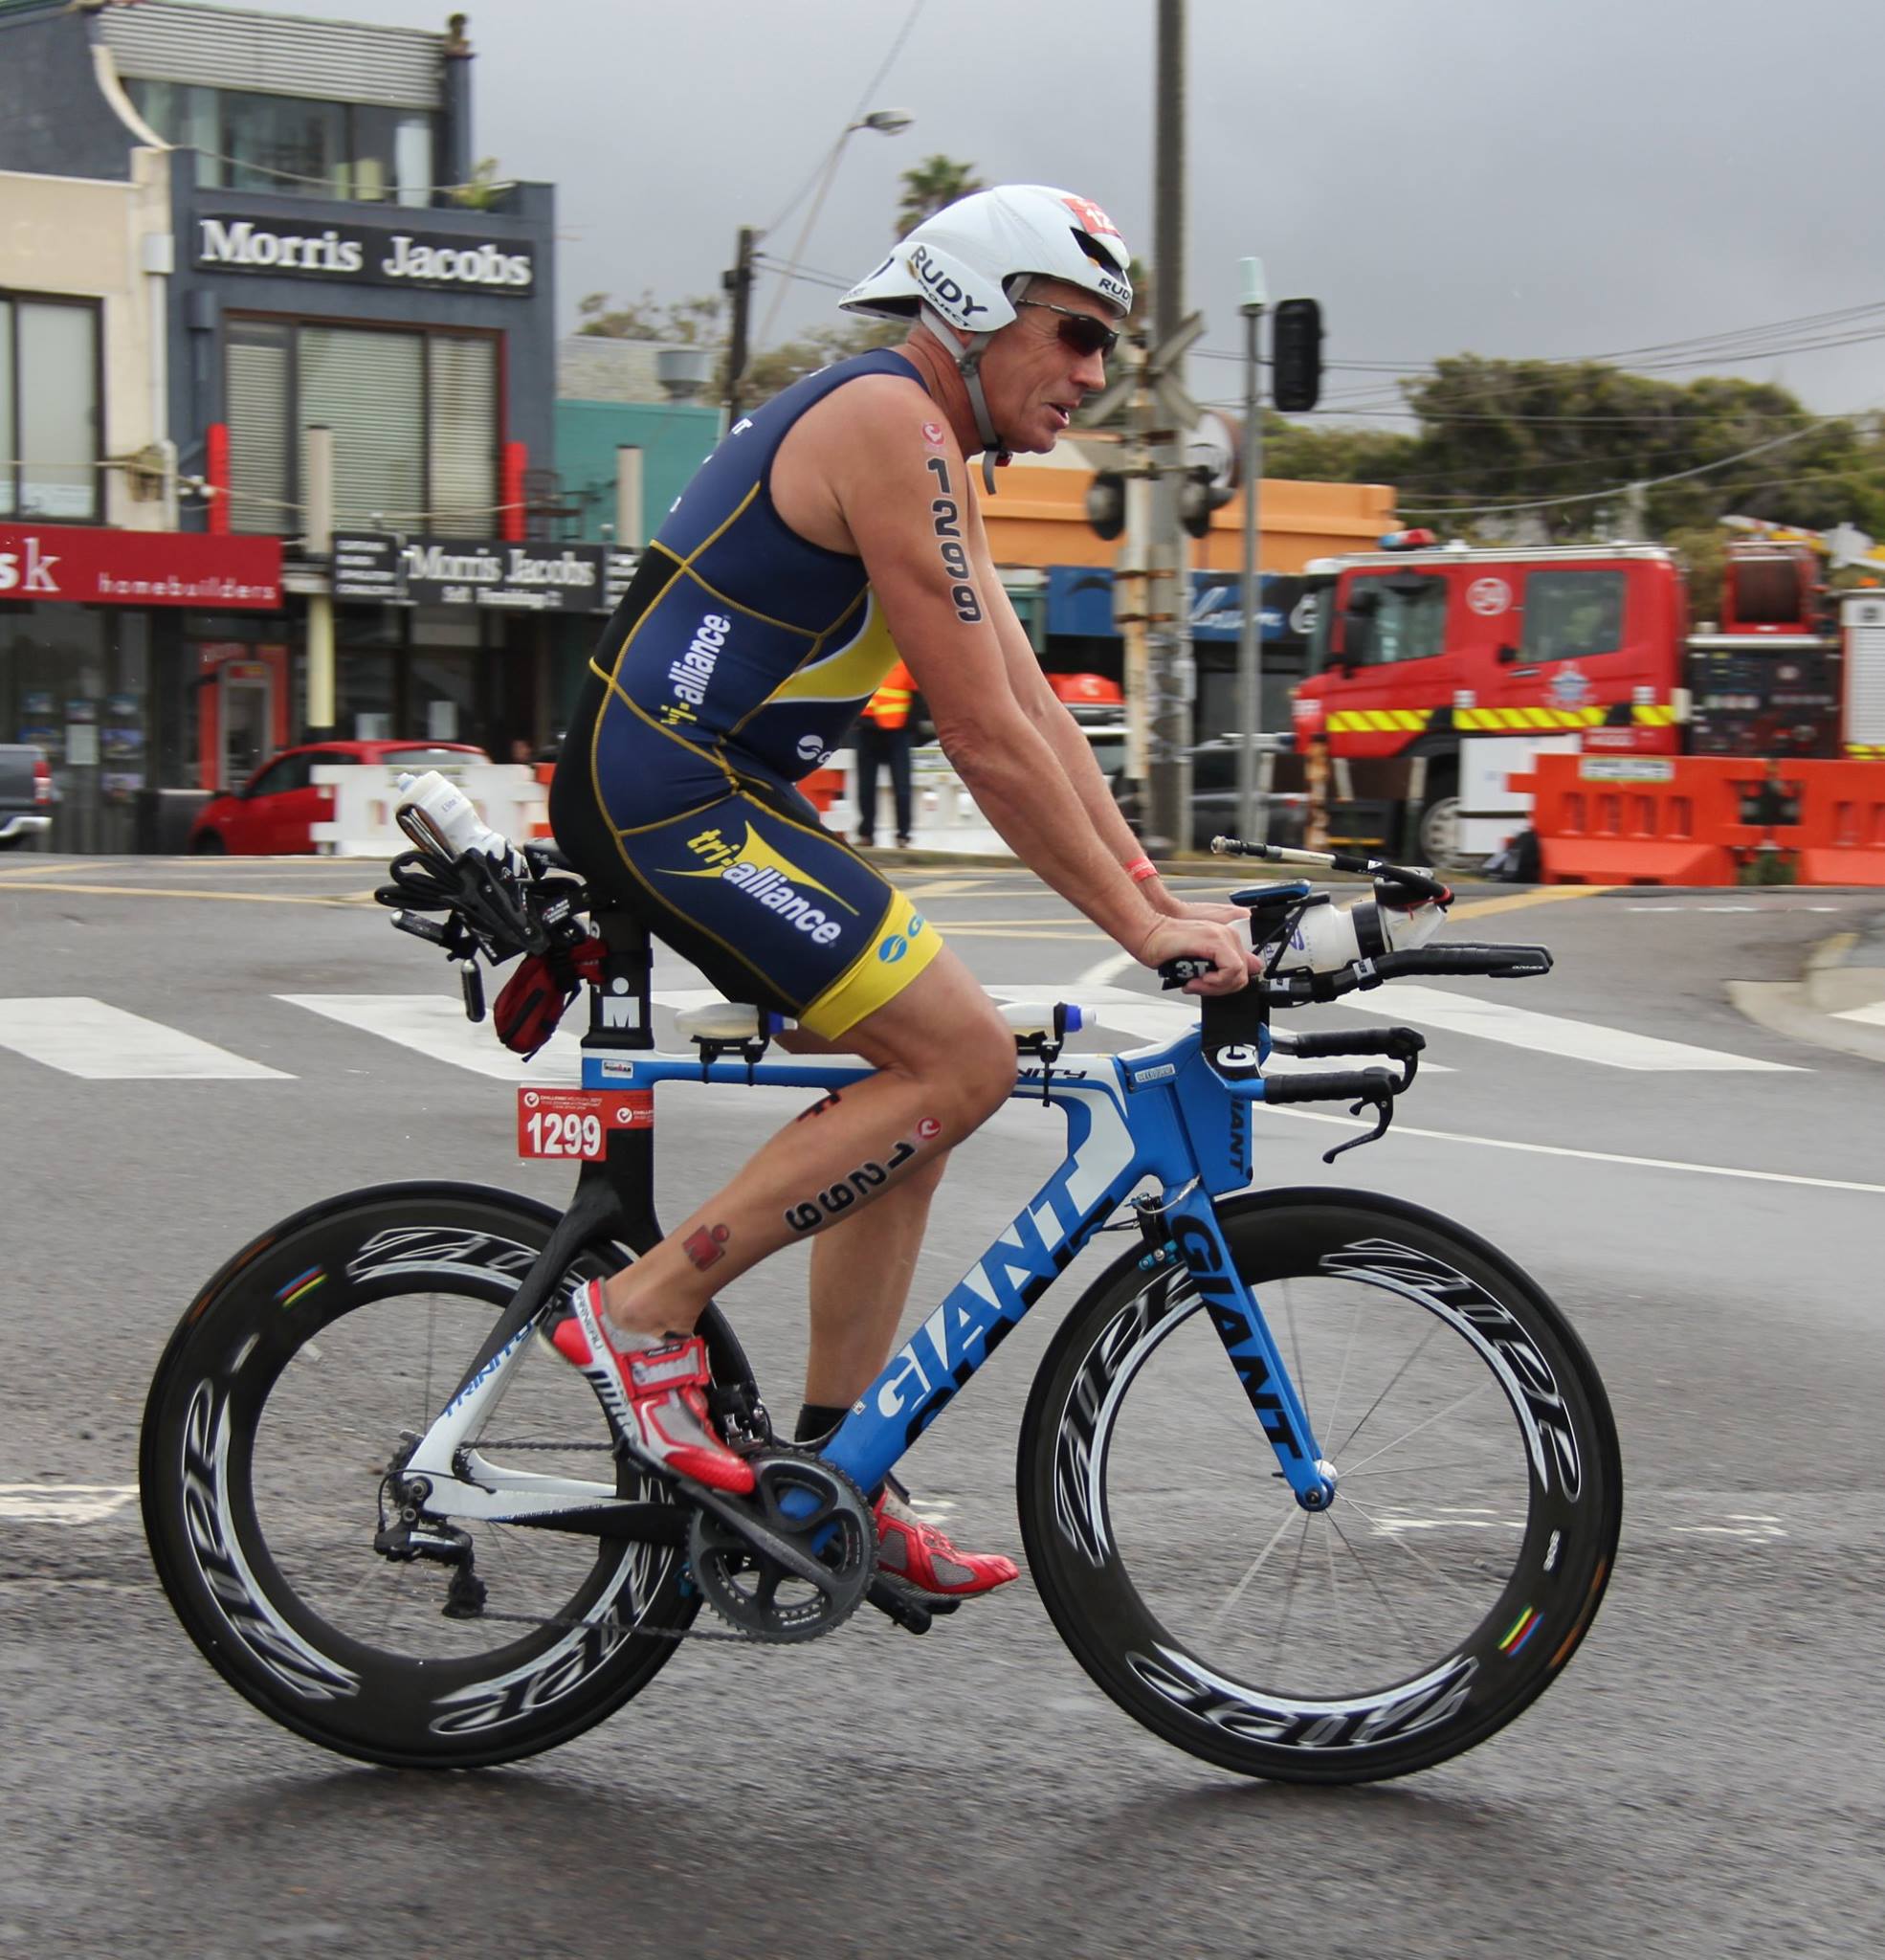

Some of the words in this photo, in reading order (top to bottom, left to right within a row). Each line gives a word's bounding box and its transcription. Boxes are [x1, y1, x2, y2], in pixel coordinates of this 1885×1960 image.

[199, 219, 364, 273] Morris
[382, 235, 532, 286] Jacobs
[910, 245, 988, 317] RUDY
[408, 544, 502, 582] Morris
[504, 548, 596, 586] Jacobs
[926, 457, 983, 623] 1299
[98, 572, 277, 600] homebuilders
[1175, 960, 1210, 978] 3T
[527, 1111, 602, 1157] 1299
[1229, 1101, 1245, 1175] IANT
[784, 1141, 917, 1233] 1299
[873, 1156, 1081, 1424] GIANT
[443, 1320, 534, 1419] TRINITY
[1173, 1212, 1305, 1460] GIANT
